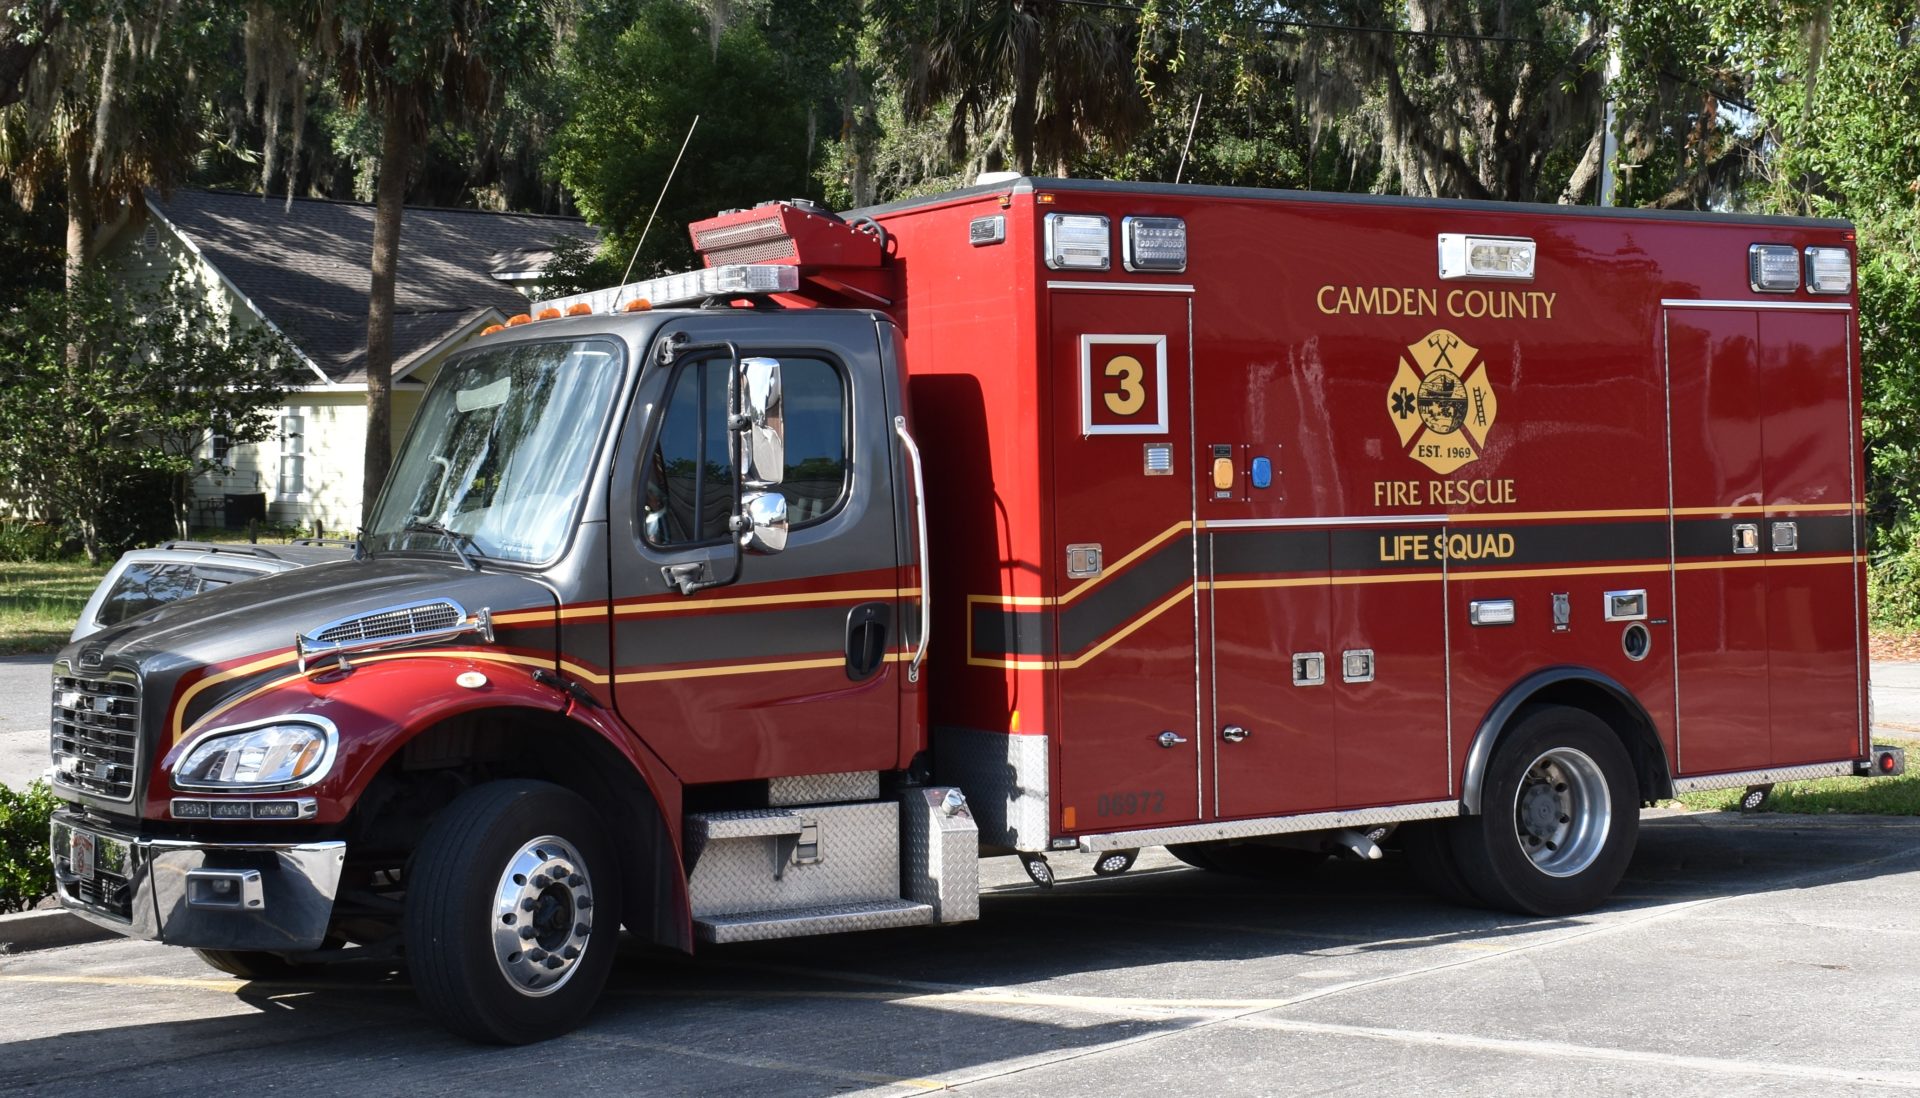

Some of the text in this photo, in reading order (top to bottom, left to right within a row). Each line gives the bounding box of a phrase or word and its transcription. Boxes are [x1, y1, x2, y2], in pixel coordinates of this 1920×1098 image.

[1316, 285, 1557, 319] CAMDEN COUNTY
[1103, 355, 1146, 416] 3
[1417, 444, 1471, 459] EST. 1969
[1373, 479, 1517, 507] FIRE RESCUE
[1379, 533, 1515, 562] LIFE SQUAD
[1097, 789, 1166, 817] 06972
